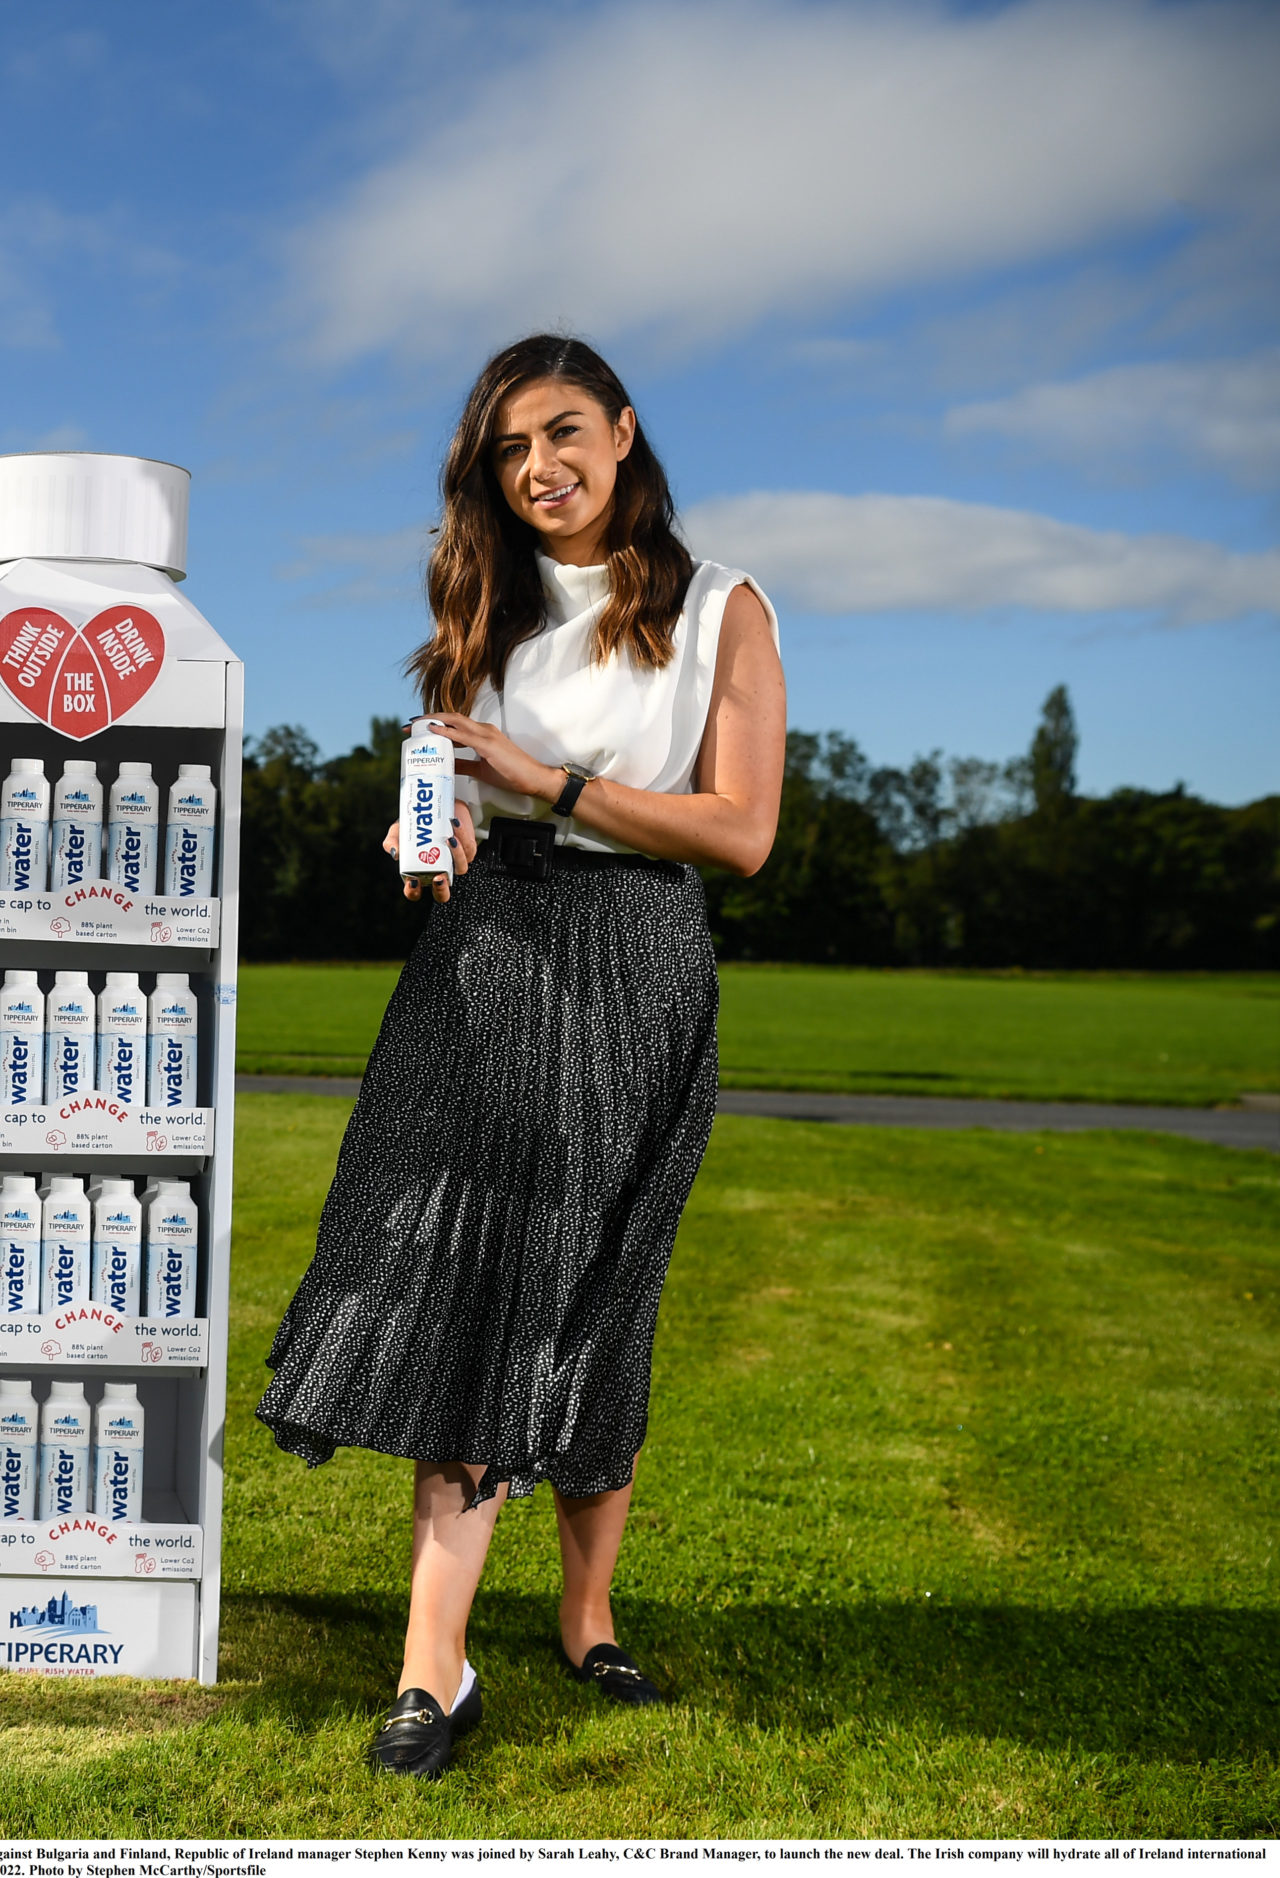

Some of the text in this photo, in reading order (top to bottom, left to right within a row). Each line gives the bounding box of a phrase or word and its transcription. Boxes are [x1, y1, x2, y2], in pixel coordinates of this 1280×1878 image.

[2, 620, 42, 669] THINK
[17, 624, 64, 688] OUTSIDE
[96, 628, 136, 680] INSIDE
[114, 618, 155, 669] DRINK
[64, 673, 94, 691] THE
[63, 694, 96, 713] BOX
[407, 756, 445, 765] TIPPERARY
[7, 801, 42, 809] TIPPERARY
[60, 802, 95, 811] TIPPERARY
[116, 804, 151, 812] TIPPERARY
[412, 778, 433, 847] water
[12, 823, 32, 891] water
[121, 826, 141, 893] water
[177, 828, 197, 897] water
[10, 900, 33, 912] cap
[37, 898, 51, 911] to
[65, 886, 133, 912] CHANGE
[145, 902, 166, 916] the
[171, 904, 211, 918] world.
[96, 922, 112, 930] plant
[4, 1014, 38, 1022] TIPPERARY
[157, 1016, 192, 1024] TIPPERARY
[9, 1036, 28, 1105] water
[114, 1038, 132, 1103] water
[164, 1038, 182, 1107] water
[5, 1114, 27, 1126] cap
[32, 1112, 45, 1123] to
[60, 1098, 128, 1122] CHANGE
[140, 1112, 161, 1124] the
[166, 1113, 205, 1125] world.
[102, 1224, 136, 1232] TIPPERARY
[6, 1243, 24, 1312] water
[108, 1246, 127, 1312] water
[163, 1248, 182, 1317] water
[0, 1324, 22, 1335] cap
[27, 1322, 41, 1333] to
[55, 1309, 124, 1333] CHANGE
[135, 1323, 156, 1336] the
[161, 1324, 201, 1337] world.
[87, 1344, 103, 1352] plant
[50, 1427, 84, 1435] TIPPERARY
[104, 1429, 139, 1437] TIPPERARY
[2, 1448, 21, 1517] water
[54, 1449, 74, 1515] water
[110, 1452, 129, 1520] water
[21, 1532, 35, 1544] to
[49, 1519, 117, 1544] CHANGE
[129, 1534, 150, 1547] the
[155, 1535, 195, 1548] world.
[80, 1555, 96, 1563] plant
